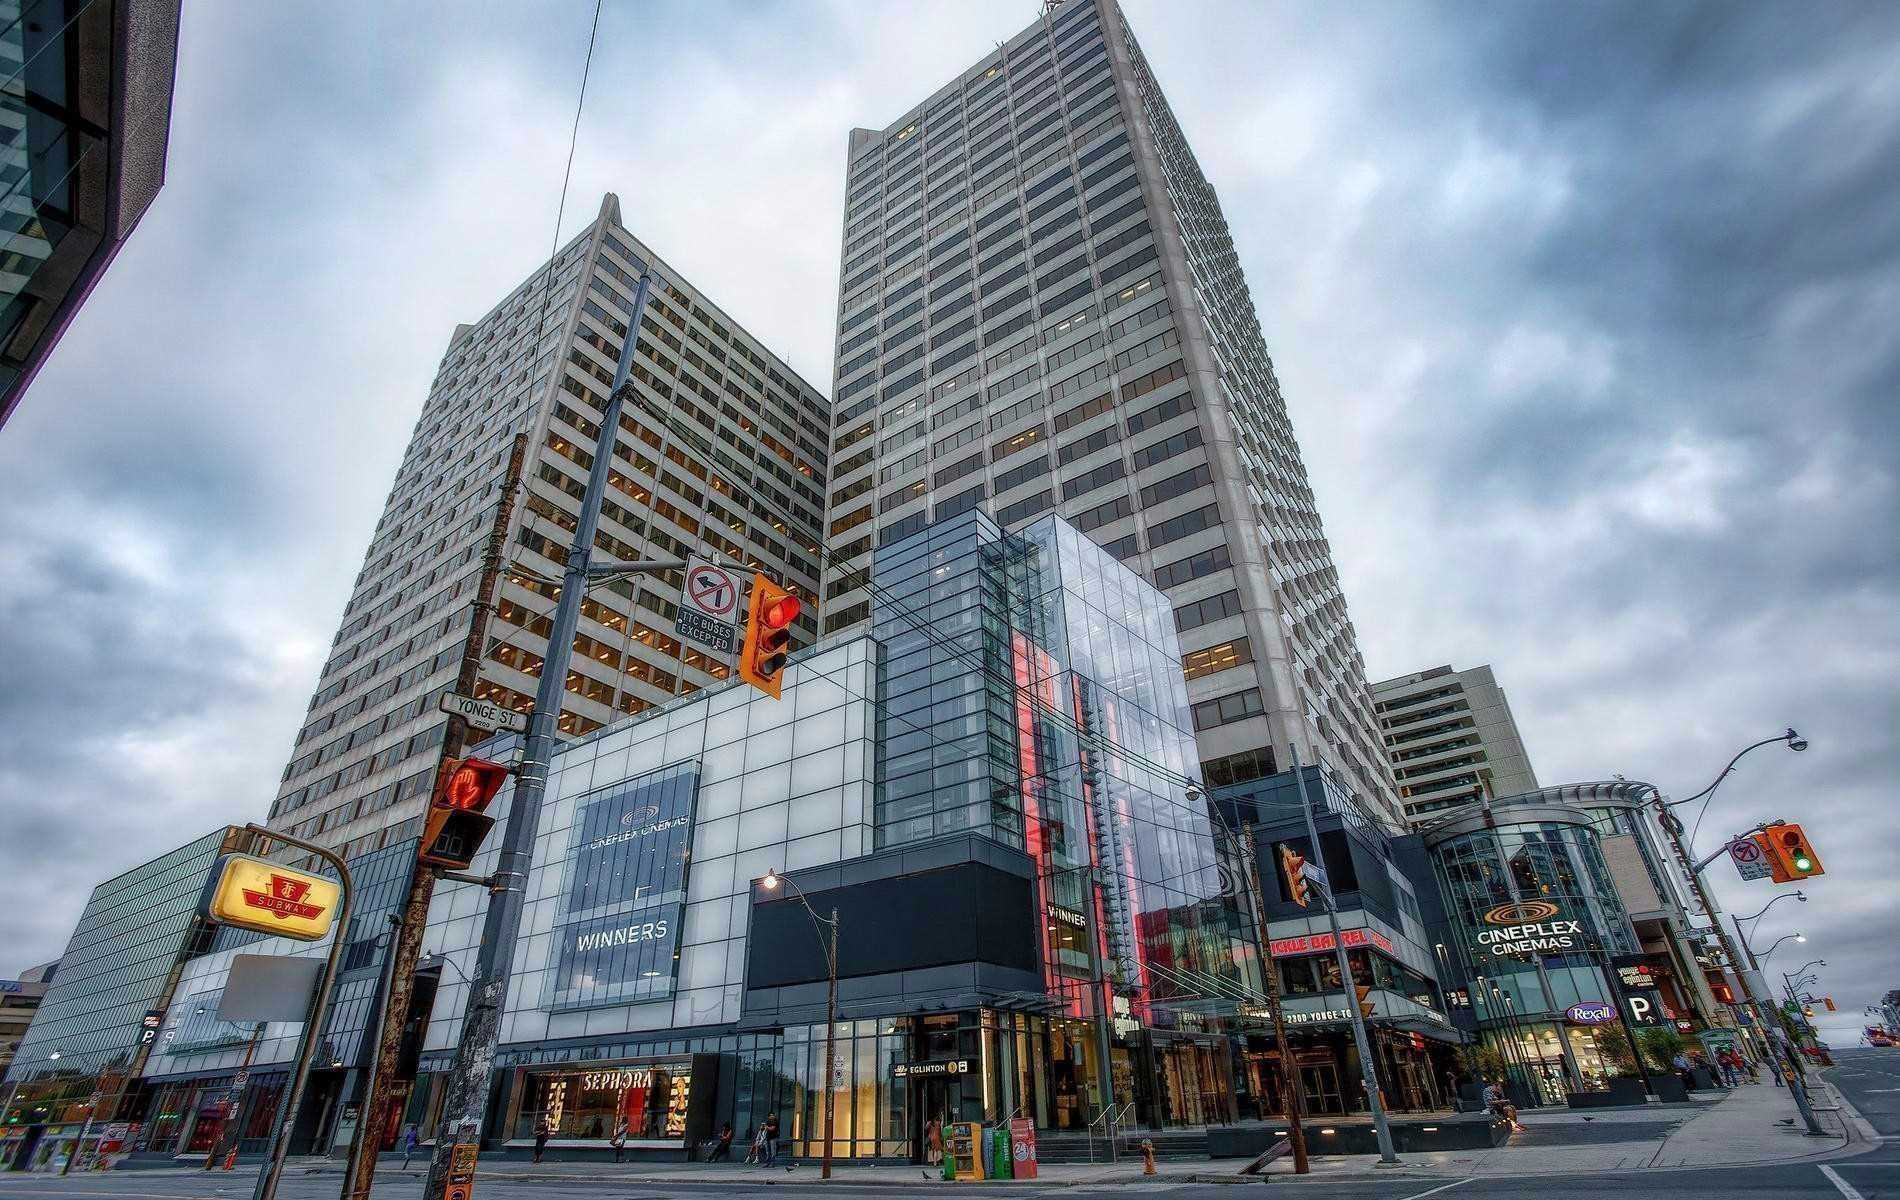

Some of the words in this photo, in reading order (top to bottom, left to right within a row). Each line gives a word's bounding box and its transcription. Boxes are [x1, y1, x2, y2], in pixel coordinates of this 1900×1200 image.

[681, 611, 699, 625] TTC
[701, 619, 731, 638] BUSES
[681, 624, 728, 649] EXCEPTED
[459, 698, 496, 720] YONGE
[500, 711, 516, 727] ST.
[257, 896, 308, 914] SUBWAY
[1048, 905, 1087, 927] WINNER
[577, 920, 668, 951] WINNERS
[1477, 920, 1583, 945] CINEPLEX
[1491, 936, 1573, 956] CINEMAS
[1286, 1012, 1307, 1024] 2300
[1310, 1010, 1338, 1021] YONGE
[1573, 1006, 1610, 1022] Rexall
[1628, 997, 1650, 1021] P
[142, 1030, 155, 1042] P
[909, 1064, 946, 1074] EGLINTON
[583, 1071, 652, 1091] SEPHORA
